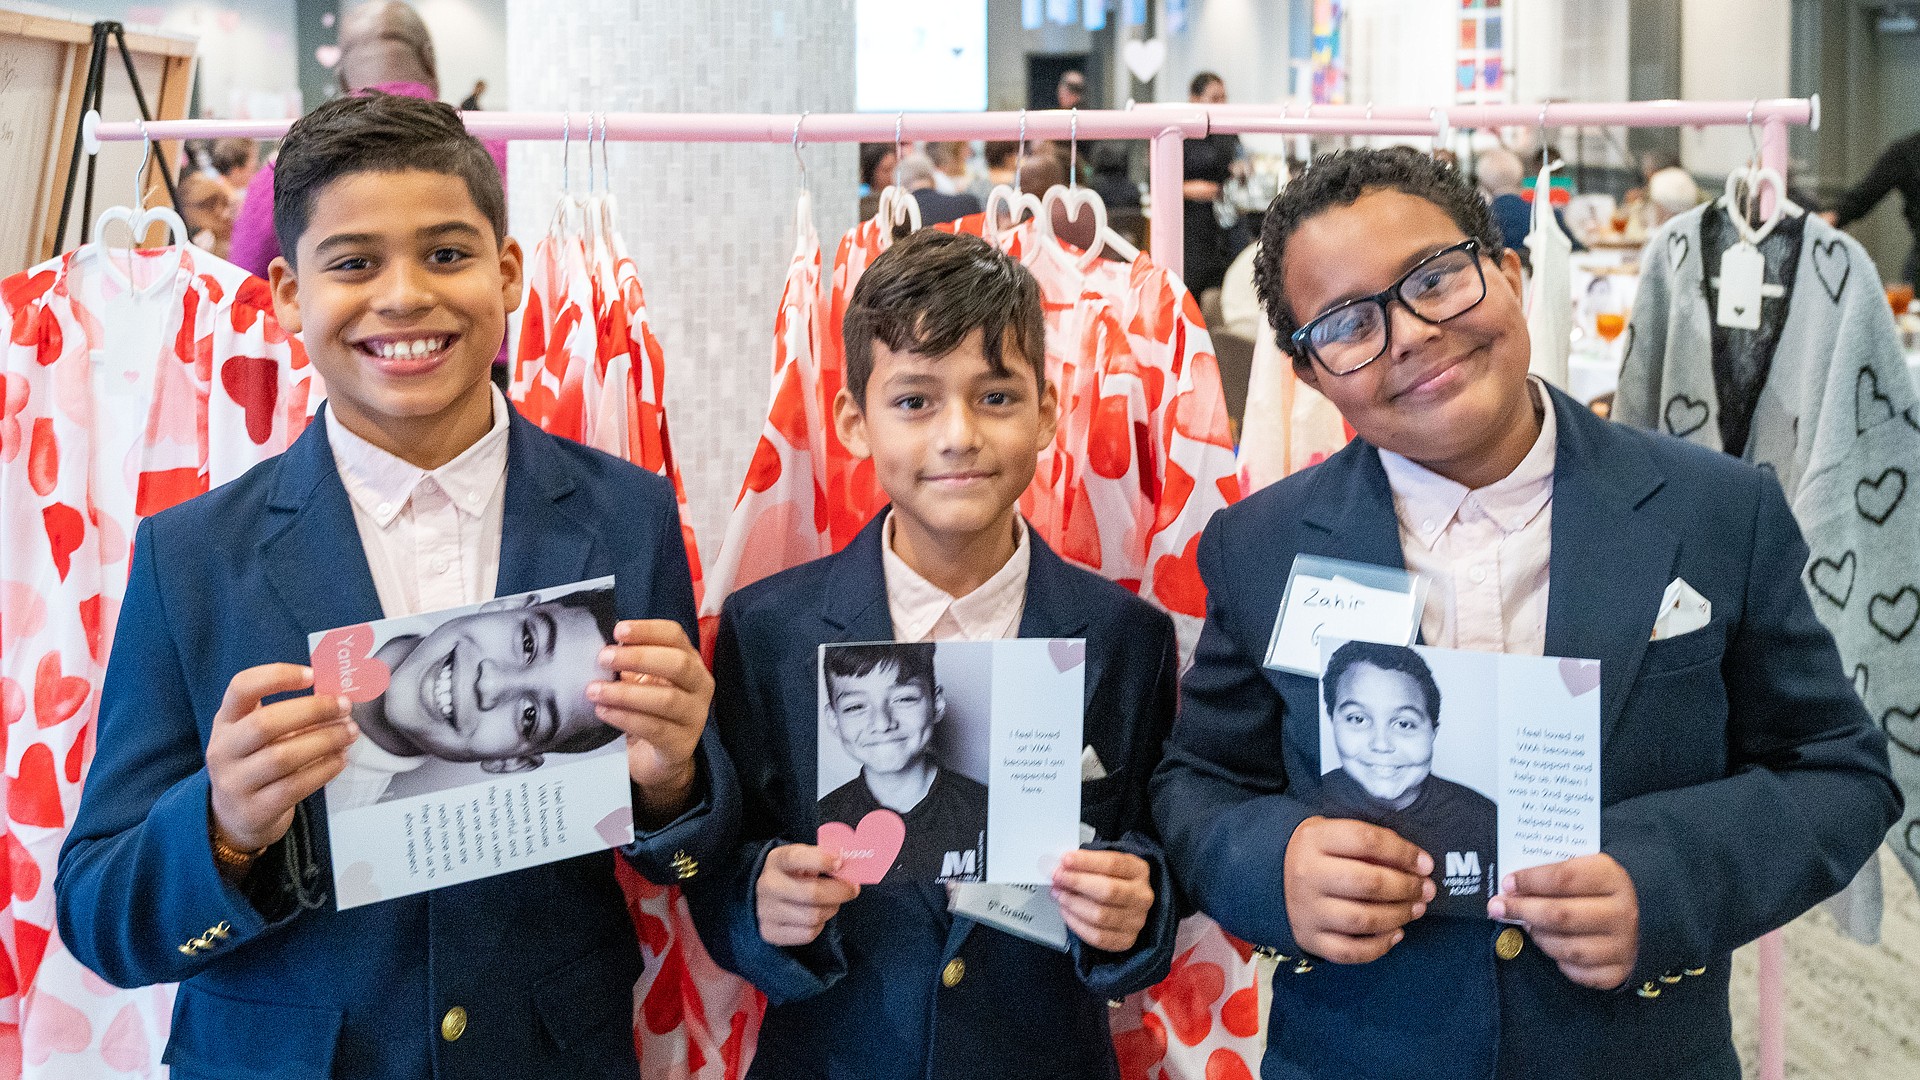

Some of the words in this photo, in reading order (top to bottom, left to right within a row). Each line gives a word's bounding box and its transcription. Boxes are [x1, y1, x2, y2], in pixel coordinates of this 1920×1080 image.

[1303, 587, 1365, 611] Zahir
[337, 633, 361, 694] Yankel
[1015, 729, 1033, 739] feel
[1035, 729, 1060, 740] loved
[1522, 726, 1541, 737] feel
[1544, 728, 1571, 740] loved
[1574, 733, 1585, 742] at
[1017, 745, 1027, 753] at
[1543, 744, 1585, 757] because
[1003, 756, 1042, 767] because
[1510, 756, 1530, 769] they
[1533, 760, 1570, 772] support
[1572, 762, 1593, 773] and
[1010, 770, 1057, 782] respected
[1514, 770, 1536, 783] help
[1554, 775, 1582, 786] When
[485, 785, 499, 804] they
[518, 782, 530, 823] everyone
[554, 785, 564, 804] feel
[1508, 788, 1527, 796] was
[1531, 788, 1539, 797] in
[1541, 788, 1561, 799] 2nd
[1563, 791, 1594, 803] grade
[418, 803, 432, 823] they
[472, 798, 480, 813] we
[436, 802, 450, 828] really
[473, 815, 481, 831] are
[487, 806, 501, 828] help
[555, 806, 567, 831] loved
[1517, 814, 1552, 828] helped
[1554, 821, 1570, 830] me
[1573, 823, 1584, 832] so
[491, 829, 499, 841] us
[539, 807, 550, 848] because
[423, 825, 435, 854] teach
[441, 830, 450, 851] nice
[508, 838, 520, 857] and
[1514, 831, 1541, 841] much
[1543, 833, 1564, 843] and
[1571, 838, 1587, 846] am
[459, 847, 467, 864] are
[492, 841, 504, 868] when
[841, 846, 876, 859] Isaac
[1522, 844, 1553, 857] better
[426, 854, 434, 867] us
[442, 852, 454, 872] and
[940, 849, 976, 878] M
[1445, 851, 1482, 877] M
[1000, 904, 1034, 923] Grader
